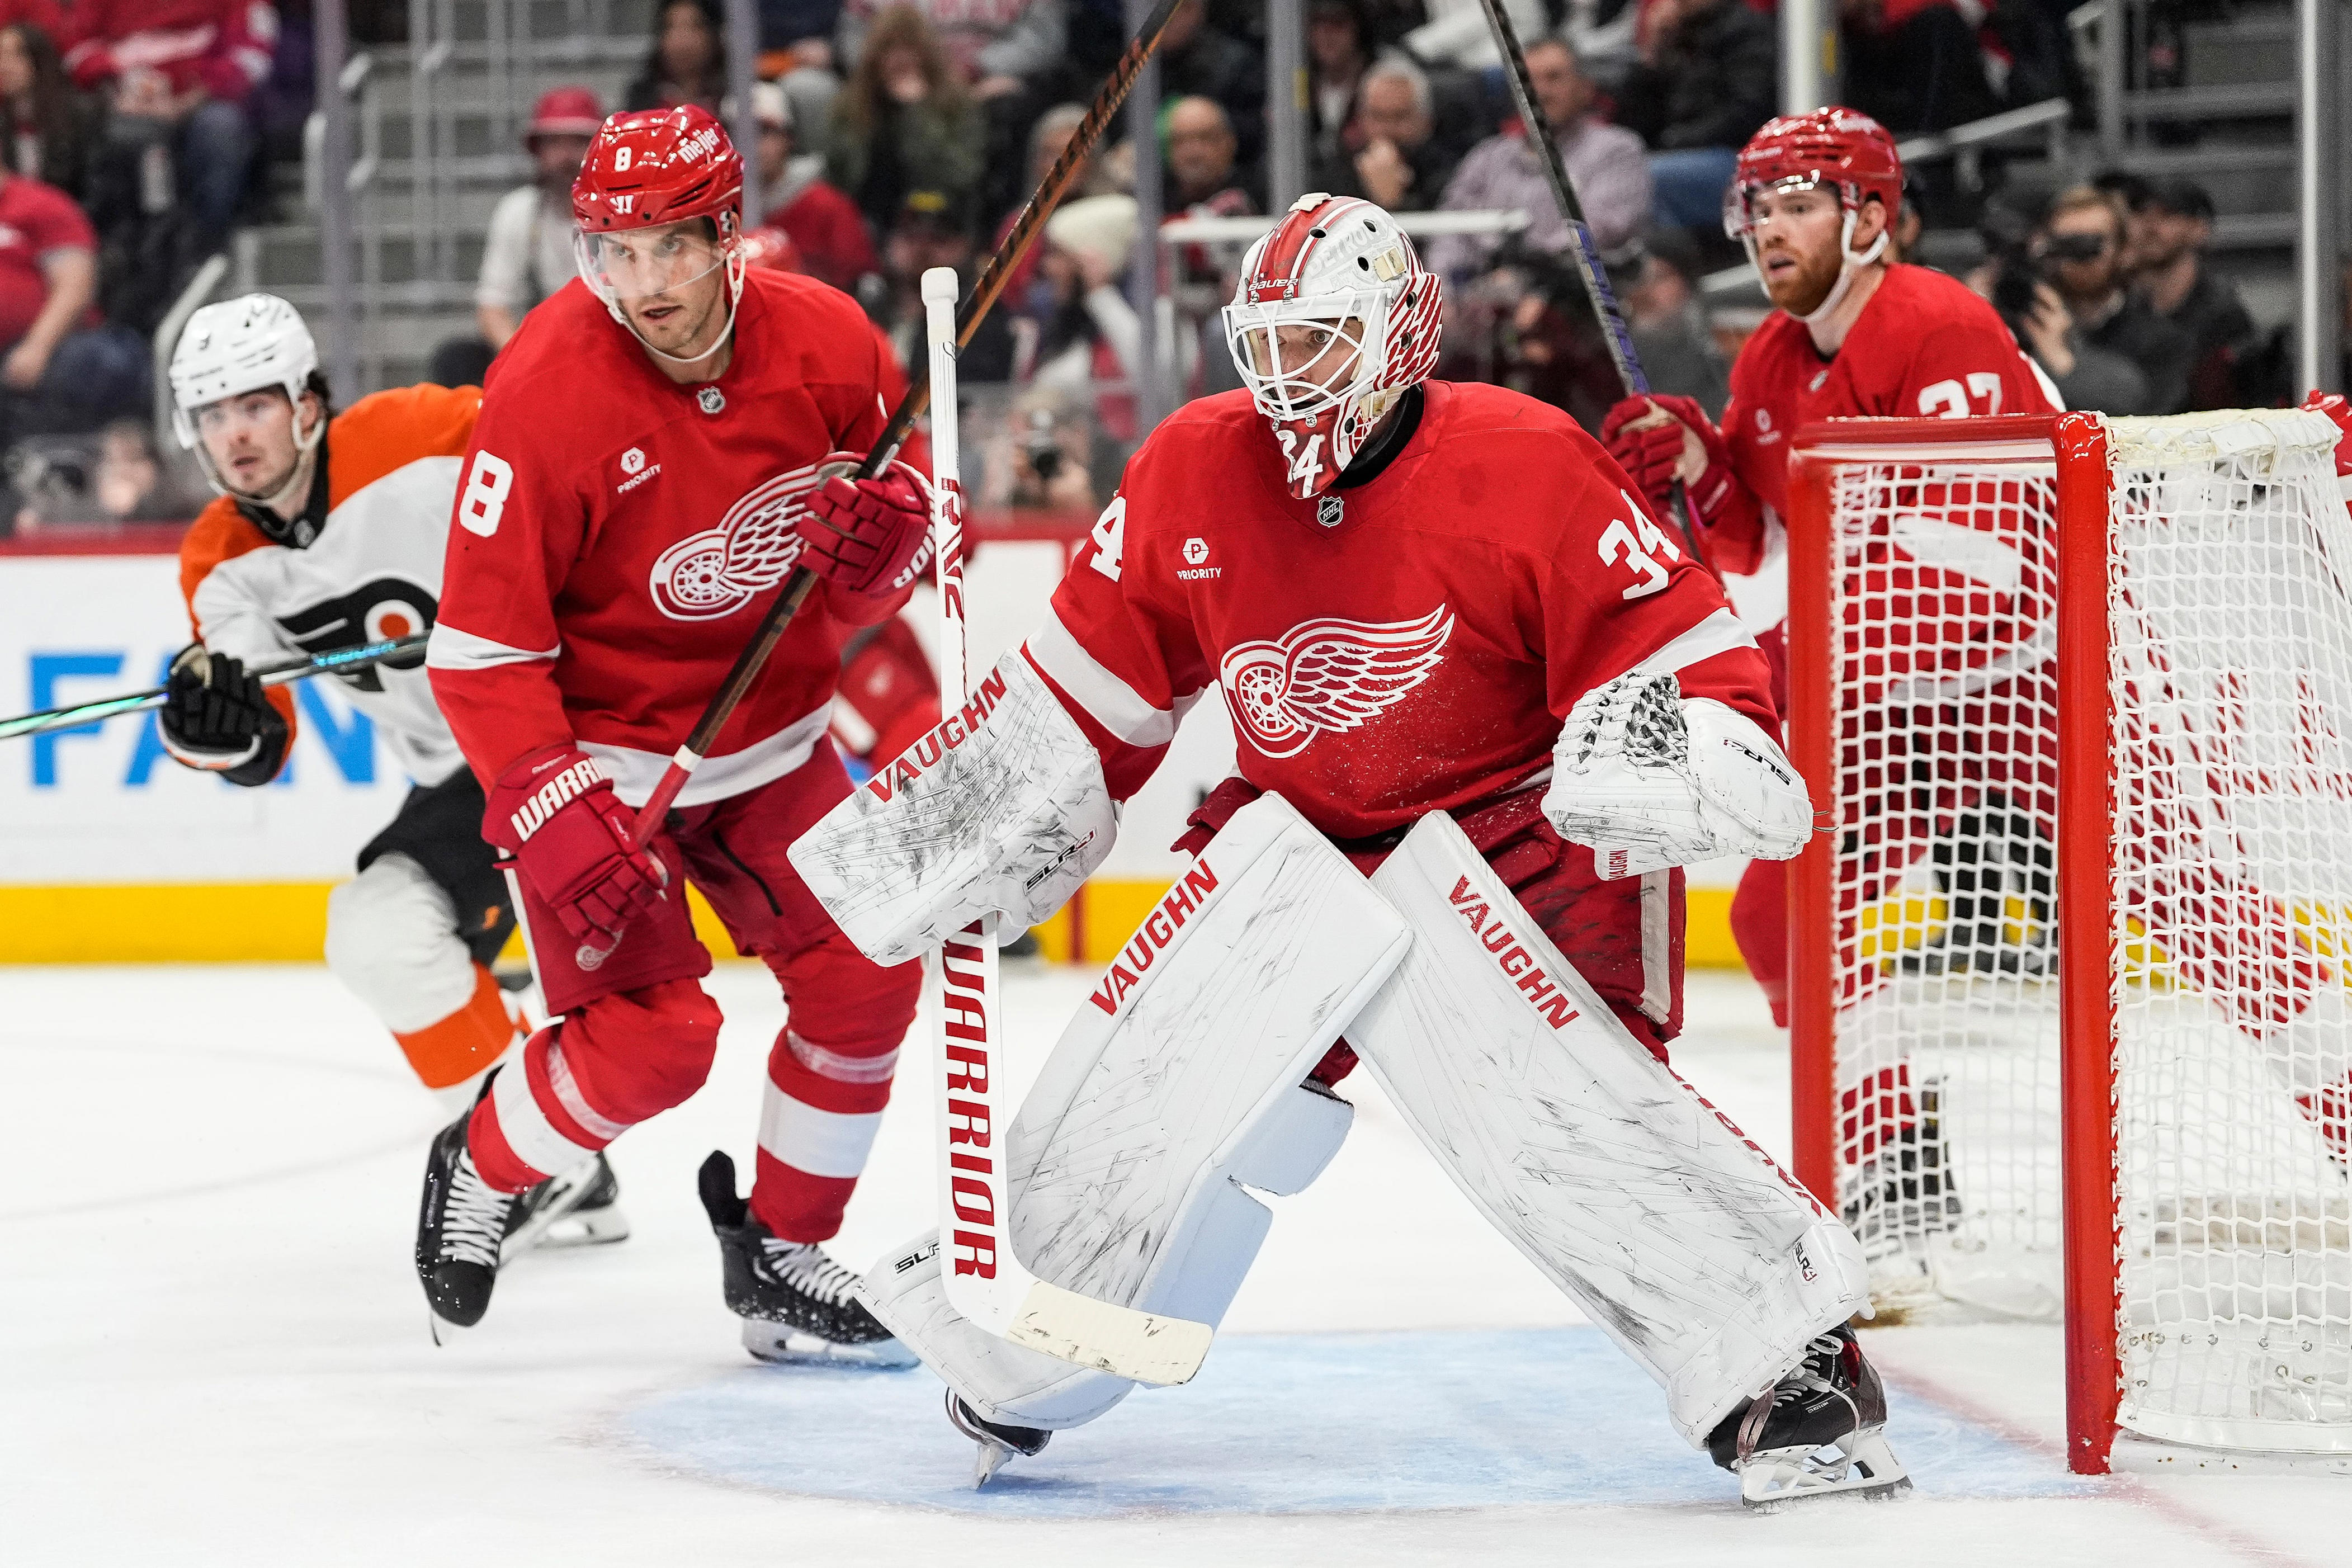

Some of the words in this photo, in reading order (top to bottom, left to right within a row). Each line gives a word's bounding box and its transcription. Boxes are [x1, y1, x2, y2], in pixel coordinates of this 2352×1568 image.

[614, 146, 632, 172] 8
[677, 127, 720, 164] meijer
[1248, 277, 1300, 291] BAUER
[459, 450, 513, 537] 8
[617, 464, 662, 494] PRIORITY
[1089, 496, 1126, 583] 4
[1323, 504, 1339, 521] NHL
[1177, 566, 1222, 580] PRIORITY
[1598, 488, 1680, 600] 34
[867, 665, 1007, 803] VAUGHN
[1608, 849, 1629, 880] VAUGHN
[1089, 857, 1220, 1017] VAUGHN
[1449, 874, 1583, 1031] VAUGHN
[942, 919, 997, 1279] WARRIOR
